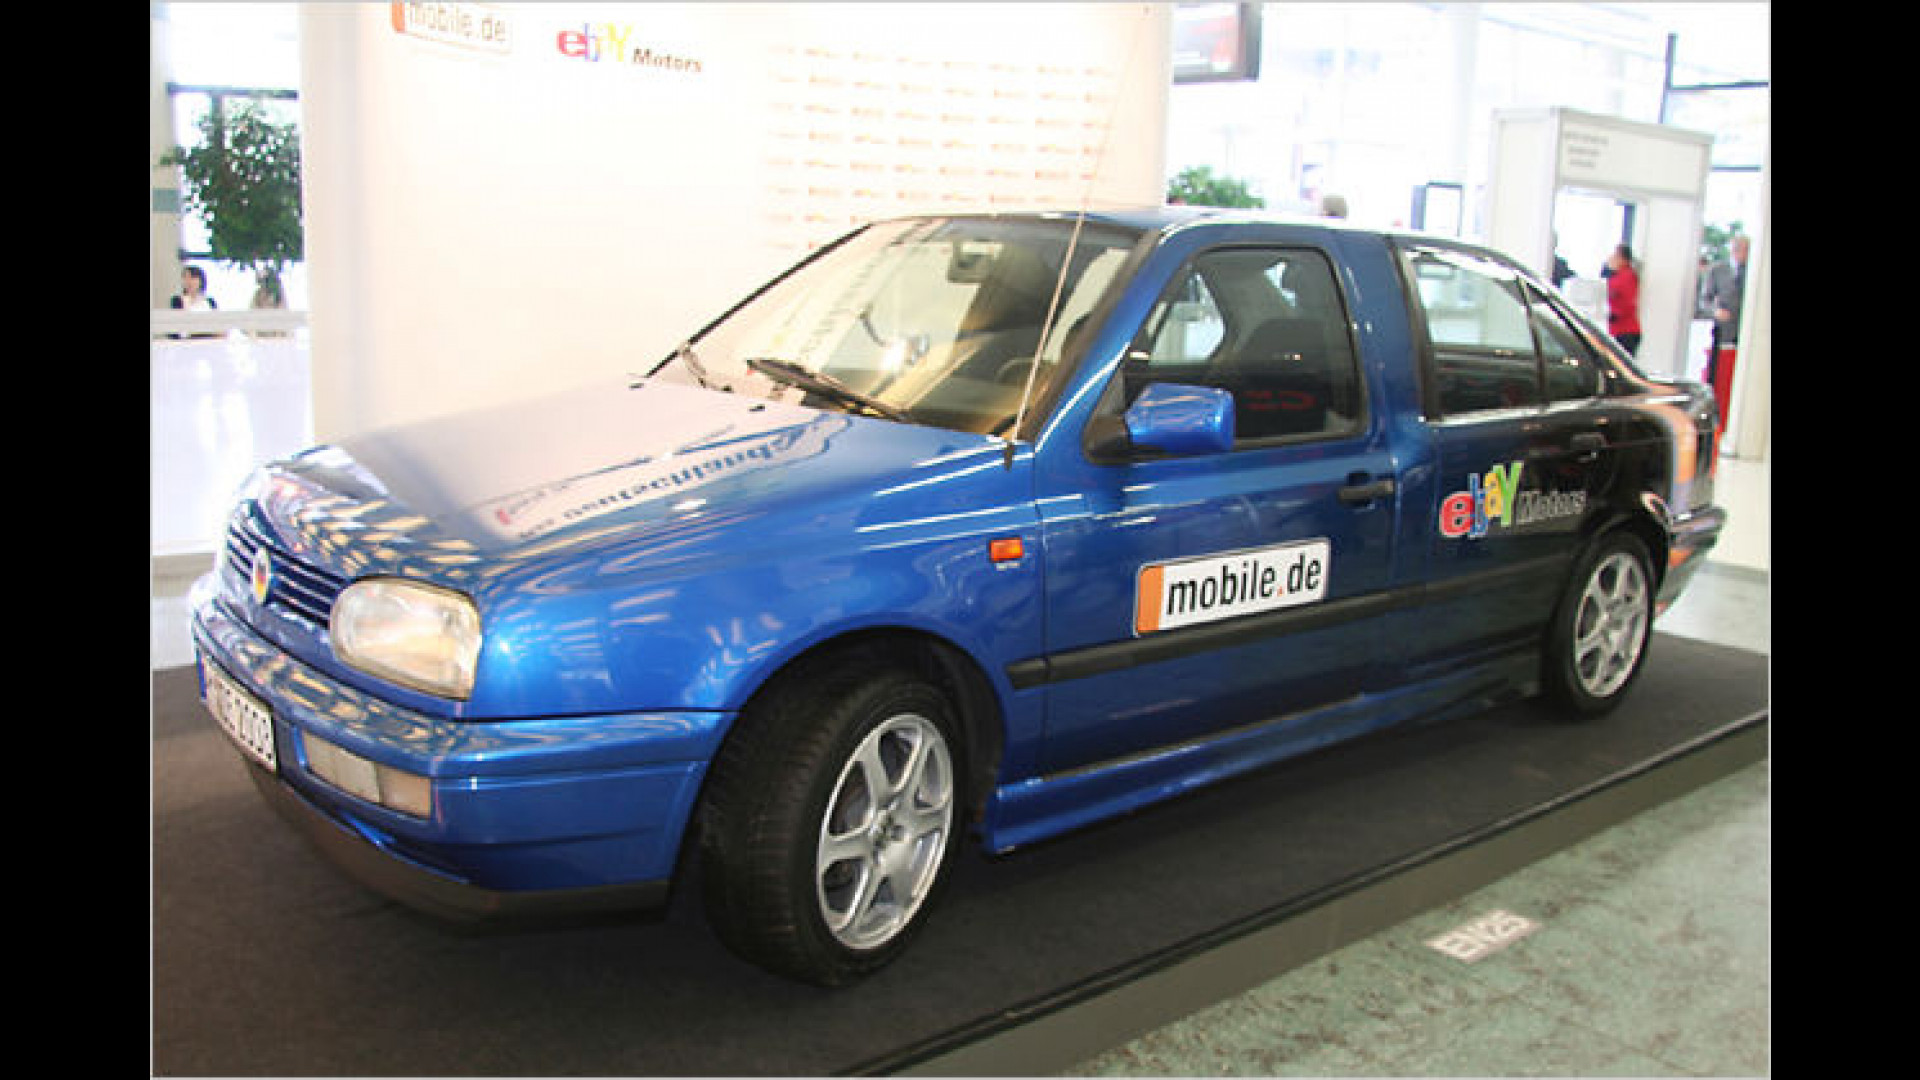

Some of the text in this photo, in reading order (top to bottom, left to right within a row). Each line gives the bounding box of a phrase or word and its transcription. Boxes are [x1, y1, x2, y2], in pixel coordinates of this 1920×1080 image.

[632, 47, 703, 73] Motors
[1515, 490, 1587, 526] Motors
[1166, 552, 1322, 616] mobile.de
